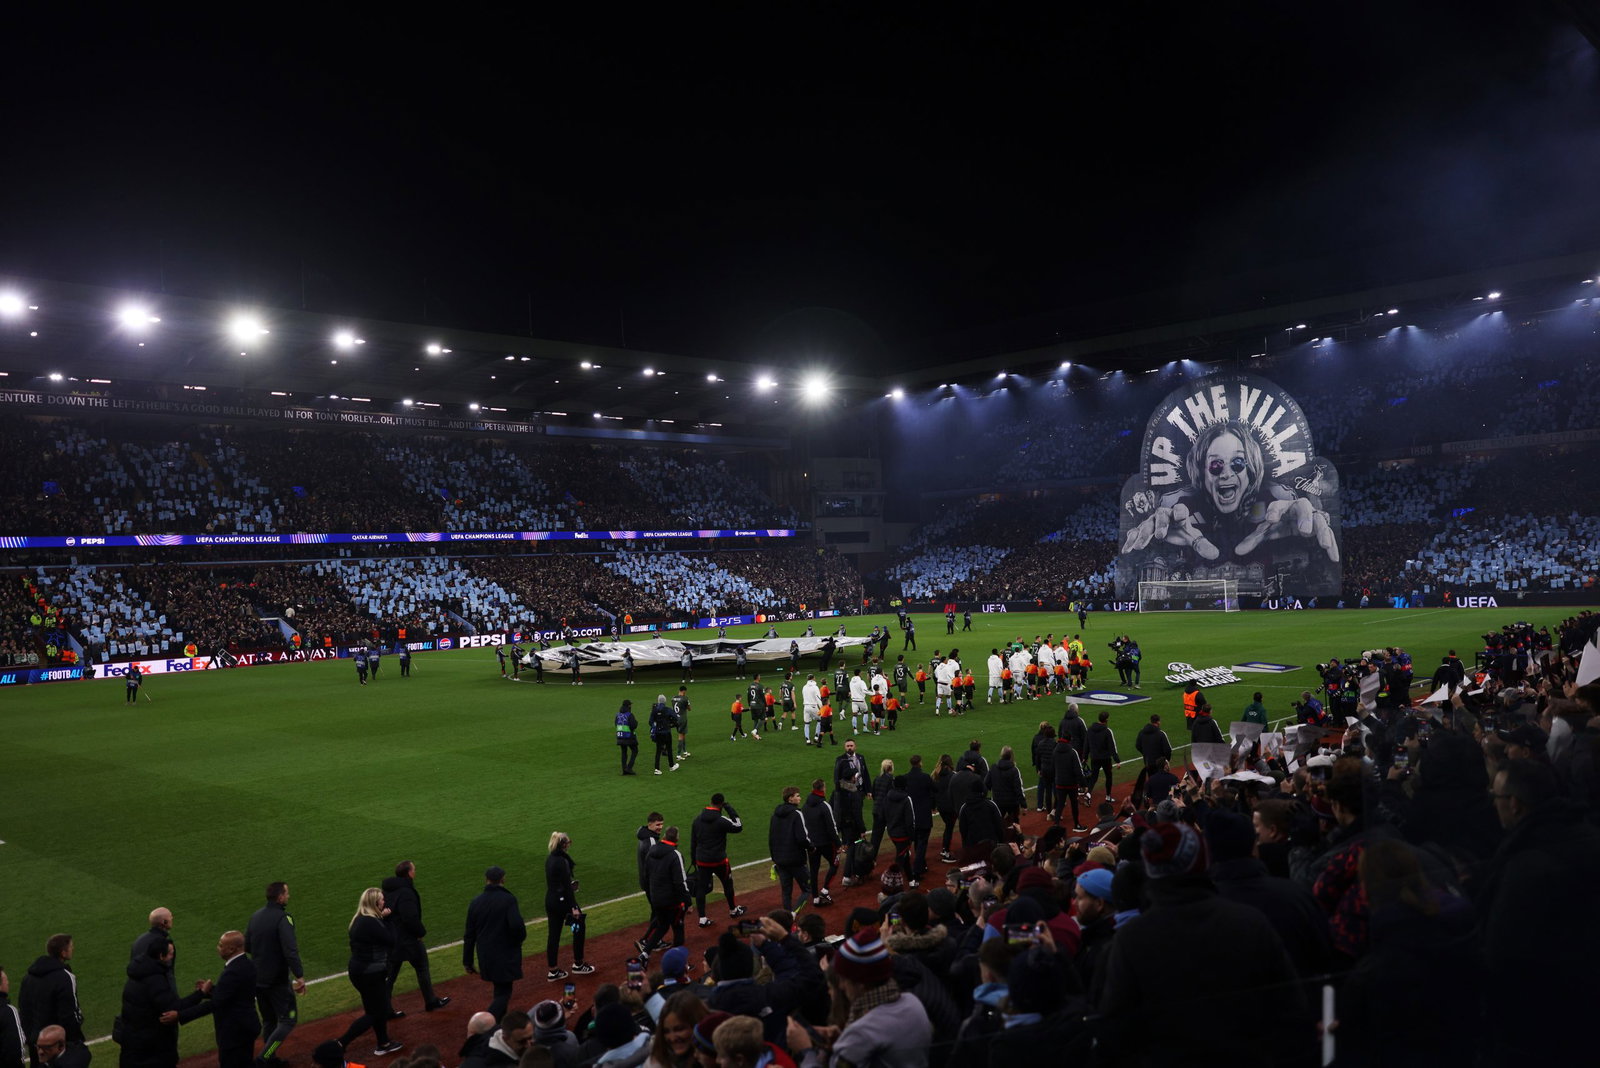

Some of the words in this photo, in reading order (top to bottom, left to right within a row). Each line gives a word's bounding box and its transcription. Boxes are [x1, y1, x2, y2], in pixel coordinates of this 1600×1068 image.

[47, 395, 86, 407] DOWN
[87, 397, 109, 408] THE
[190, 403, 220, 414] GOOD
[223, 406, 245, 416] BALL
[247, 407, 280, 418] PLAYED
[284, 410, 294, 419] IN
[295, 410, 313, 420] FOR
[314, 411, 340, 421] TONY
[404, 417, 426, 427] MUST
[484, 421, 505, 432] PETER
[1150, 436, 1182, 486] UP
[1166, 384, 1230, 444] THE
[1238, 383, 1307, 478] VILLA
[80, 537, 105, 545] PEPSI
[214, 535, 255, 543] CHAMPIONS
[255, 535, 281, 543] LEAGUE
[982, 603, 1007, 613] UEFA
[1456, 595, 1498, 608] UEFA
[719, 616, 741, 626] PS5
[459, 633, 506, 649] PEPSI
[0, 673, 17, 684] ALL
[1164, 665, 1233, 684] CHAMPIONS
[1196, 672, 1242, 688] LEAGUE
[750, 690, 756, 700] 9
[673, 701, 680, 714] 6
